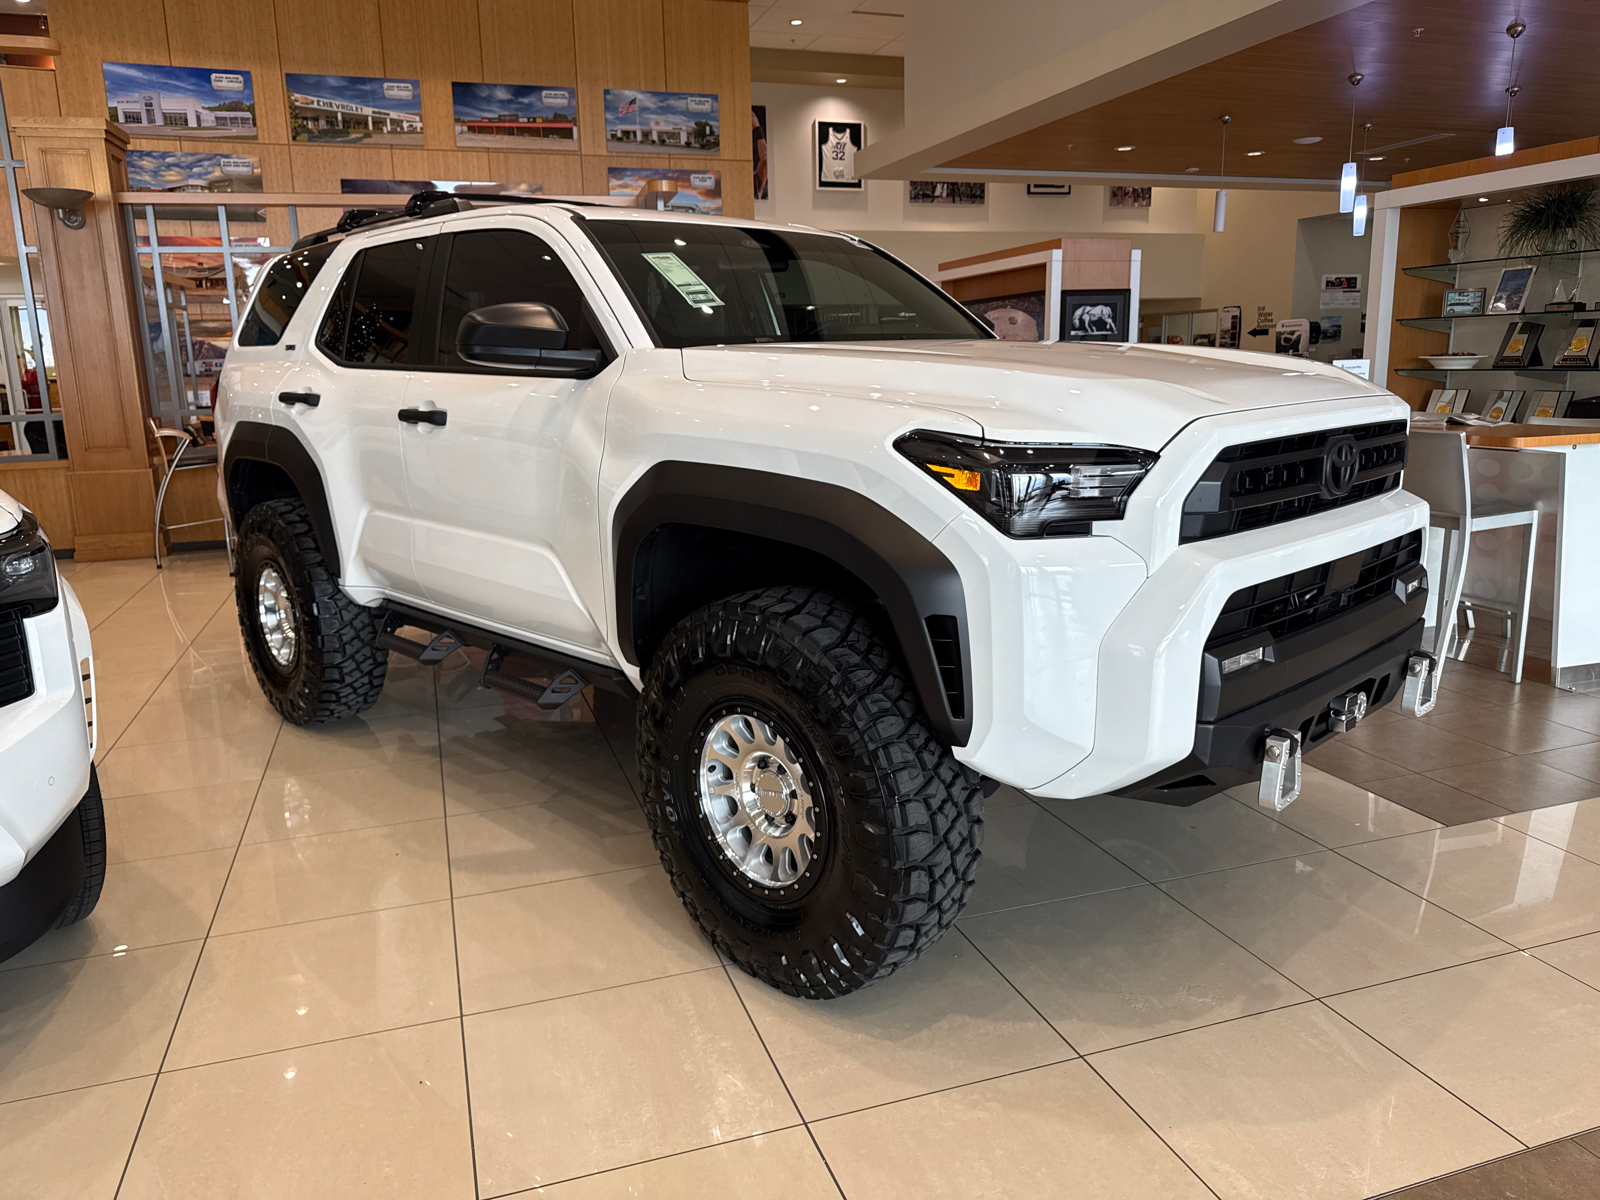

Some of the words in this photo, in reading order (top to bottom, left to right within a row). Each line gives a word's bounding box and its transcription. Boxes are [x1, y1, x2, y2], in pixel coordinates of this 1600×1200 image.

[316, 99, 364, 113] CHEVROLET
[832, 151, 846, 161] 32
[714, 663, 768, 687] OPEN
[660, 765, 685, 842] TOYO
